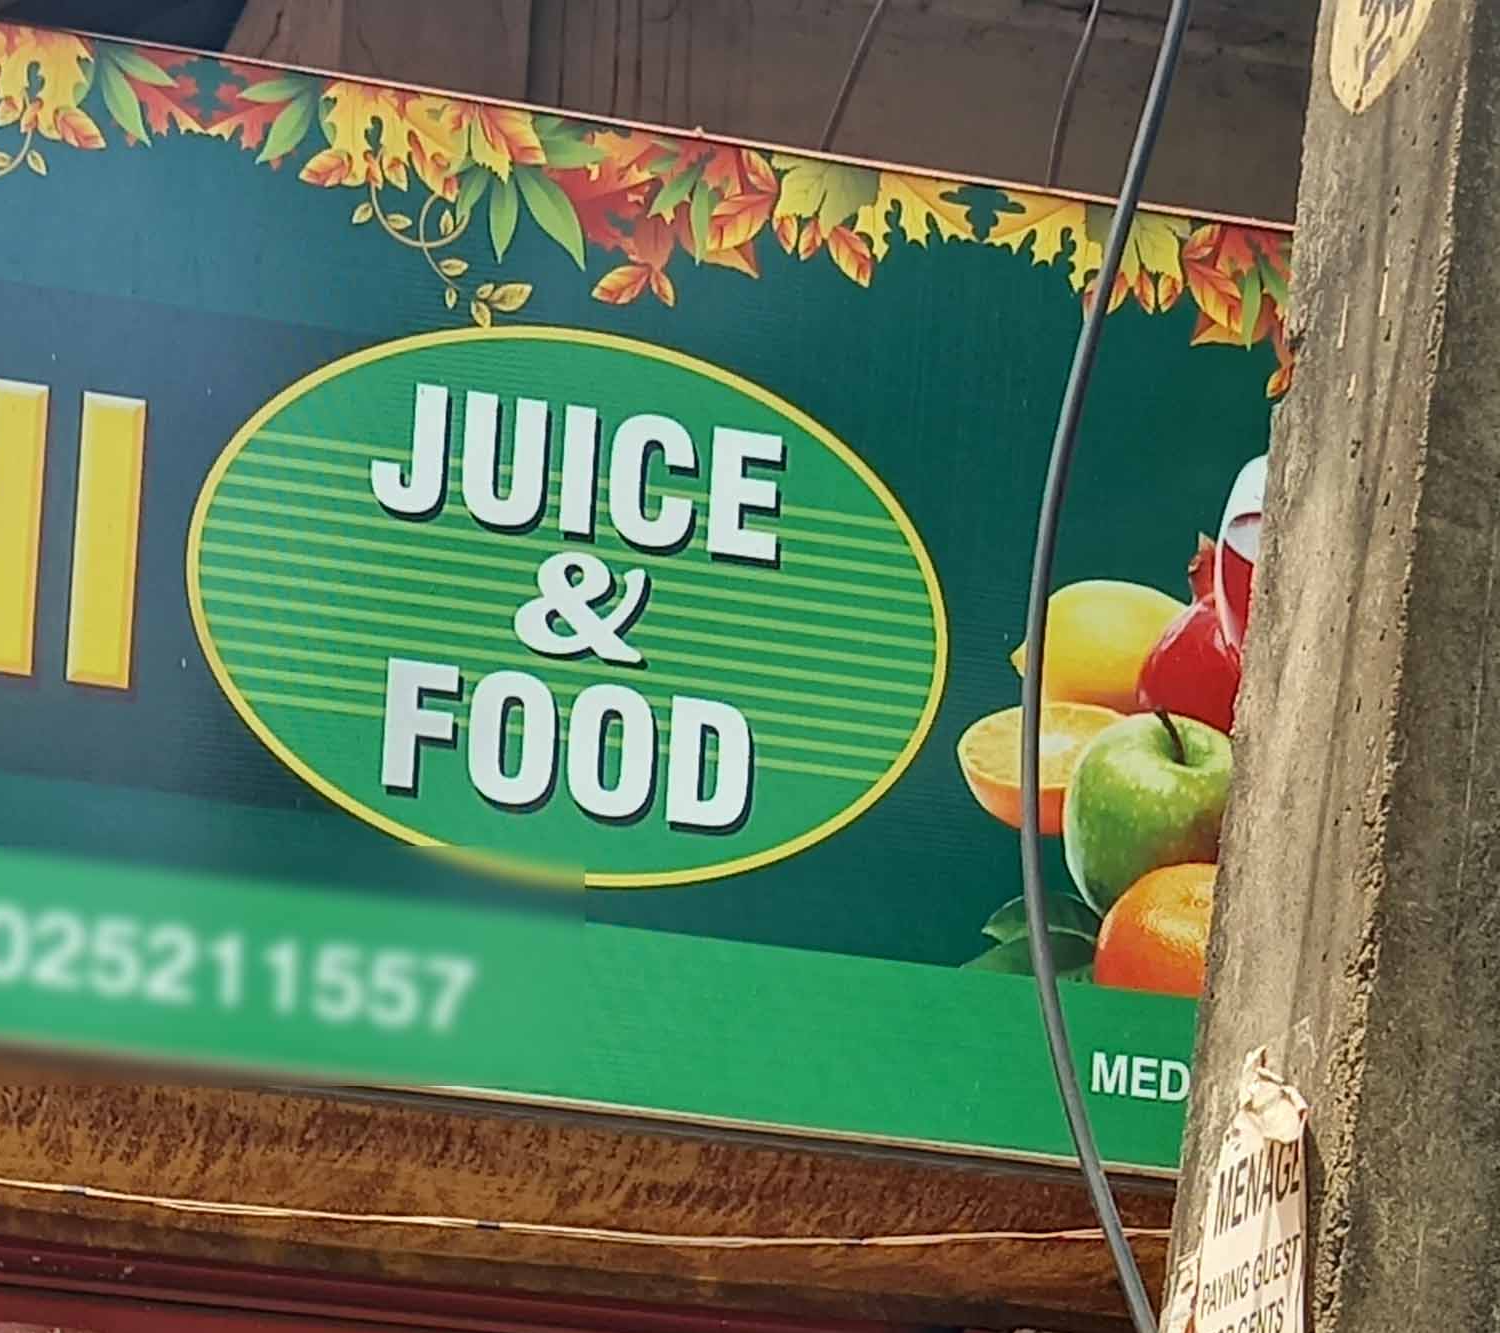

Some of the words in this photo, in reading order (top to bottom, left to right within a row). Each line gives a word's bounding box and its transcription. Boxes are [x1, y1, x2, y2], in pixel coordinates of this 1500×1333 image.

[368, 382, 784, 563] JUICE
[513, 550, 649, 664] &
[381, 657, 752, 830] FOOD
[1201, 1260, 1249, 1319] PAYING
[1253, 1234, 1300, 1291] GUEST
